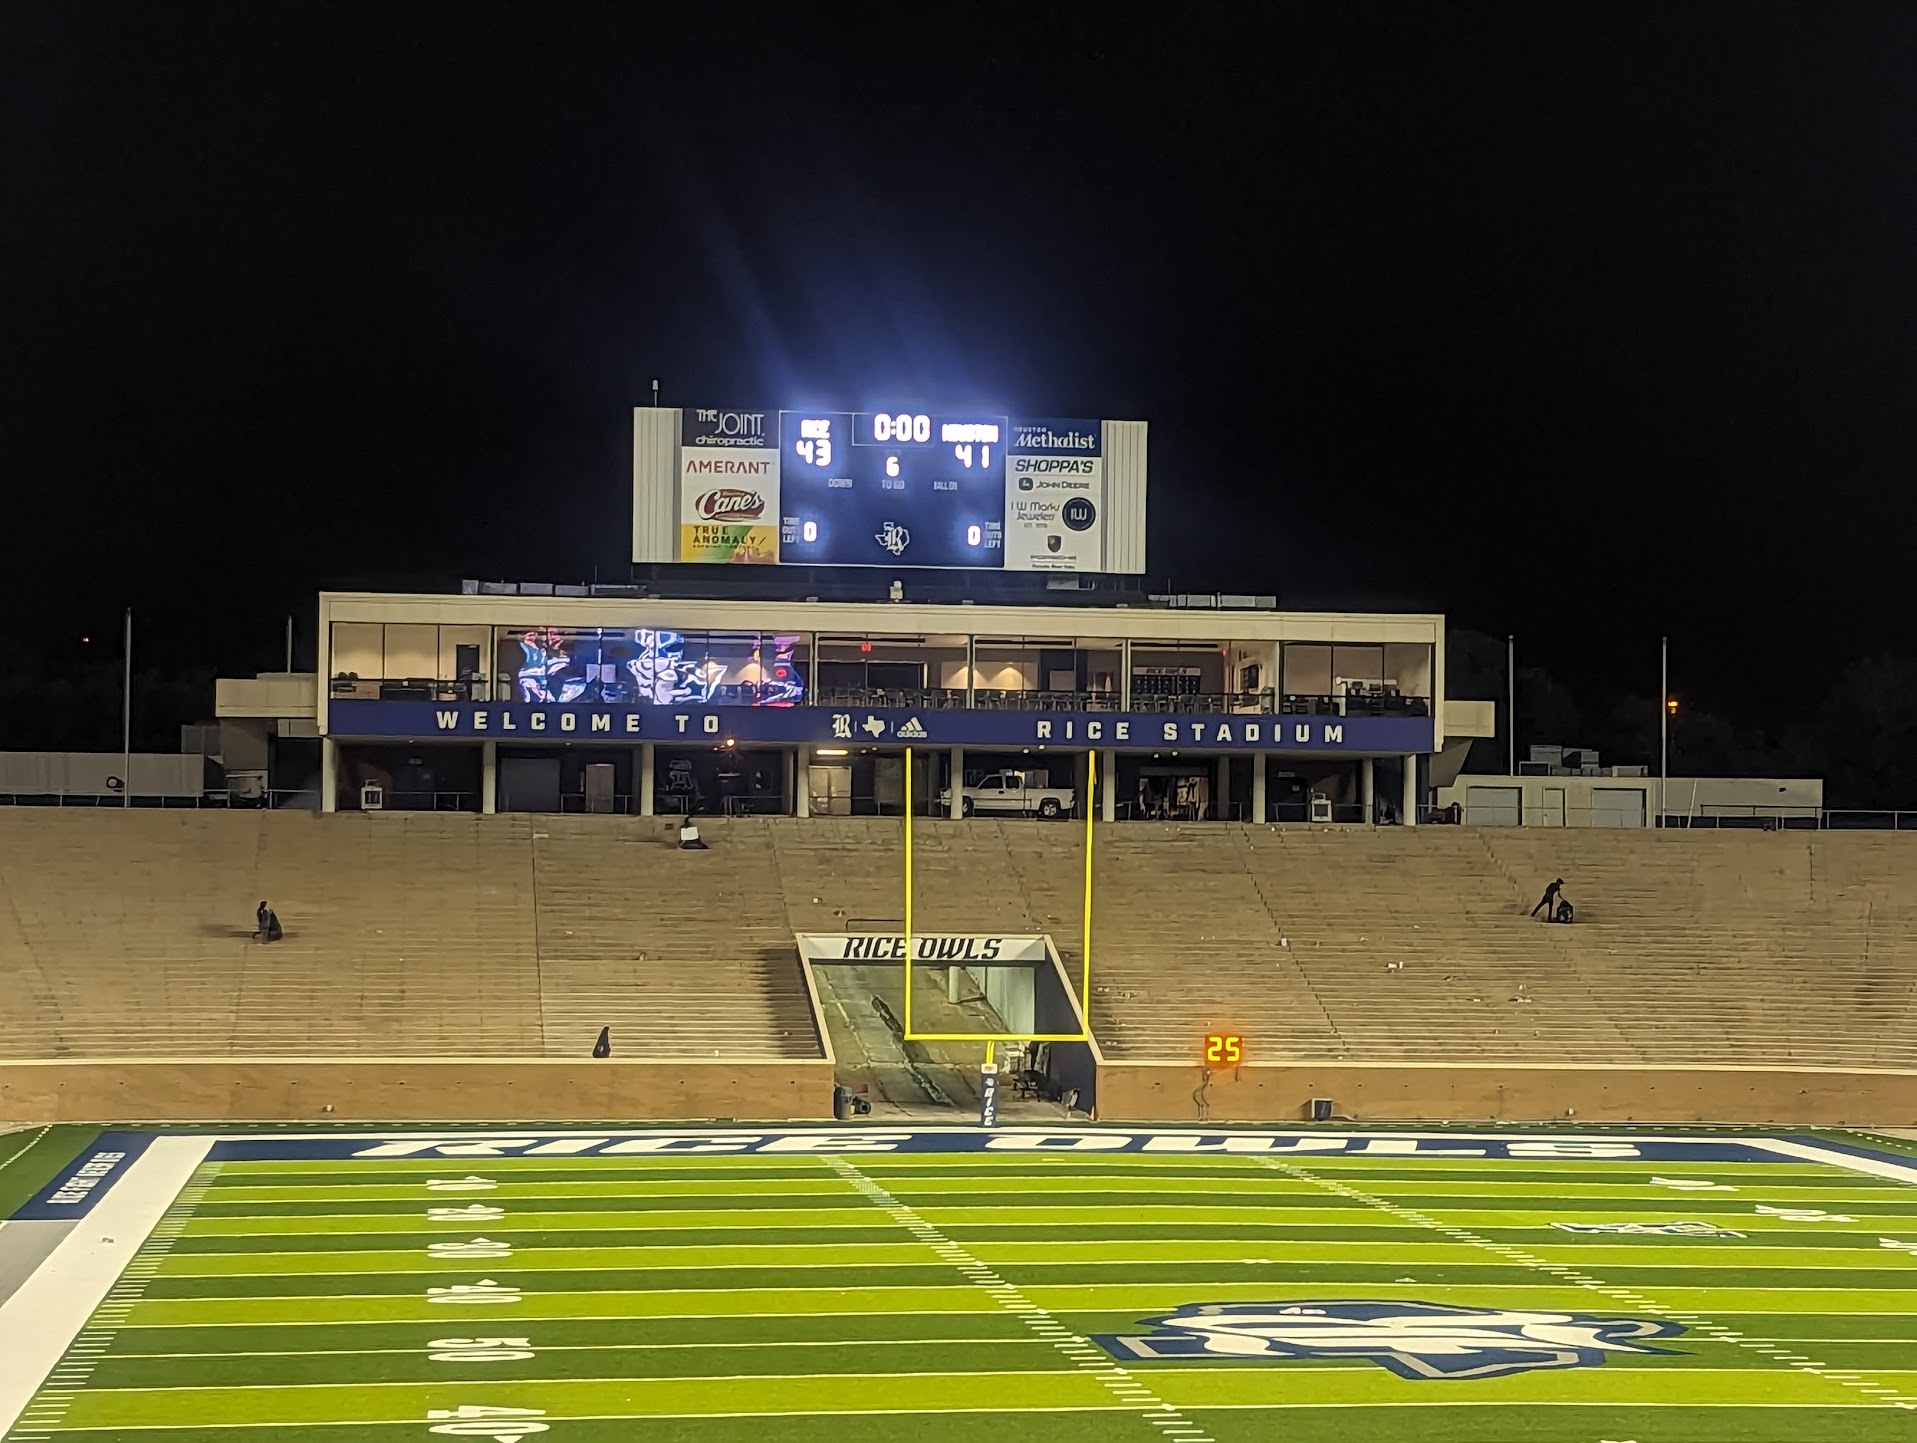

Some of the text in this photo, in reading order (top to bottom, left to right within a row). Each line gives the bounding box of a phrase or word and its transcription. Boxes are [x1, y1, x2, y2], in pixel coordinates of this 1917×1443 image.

[696, 409, 718, 422] THE
[874, 413, 931, 442] 0:00
[695, 435, 764, 447] chiropractic
[1013, 431, 1096, 449] Methodist
[796, 439, 832, 467] 43
[955, 444, 990, 468] 41
[686, 460, 771, 474] AMERANT
[886, 456, 900, 477] 6
[1015, 458, 1094, 473] SHOPPA'S
[882, 480, 891, 489] TO
[1036, 481, 1090, 489] JOHN DEERE
[698, 488, 763, 519] Cane's
[1030, 501, 1060, 512] Marks
[1016, 511, 1055, 521] Jewelers
[693, 525, 729, 535] TRUE
[693, 535, 757, 546] ANOMALY
[803, 521, 818, 542] 0
[967, 525, 981, 546] 0
[437, 711, 719, 733] WELCOME TO
[1037, 720, 1343, 743] RICE STADIUM
[843, 936, 1003, 960] RICE OWLS
[1207, 1036, 1240, 1062] 25
[352, 1133, 1641, 1158] RICE OWLS
[427, 1337, 535, 1362] 50
[427, 1405, 550, 1435] 40
